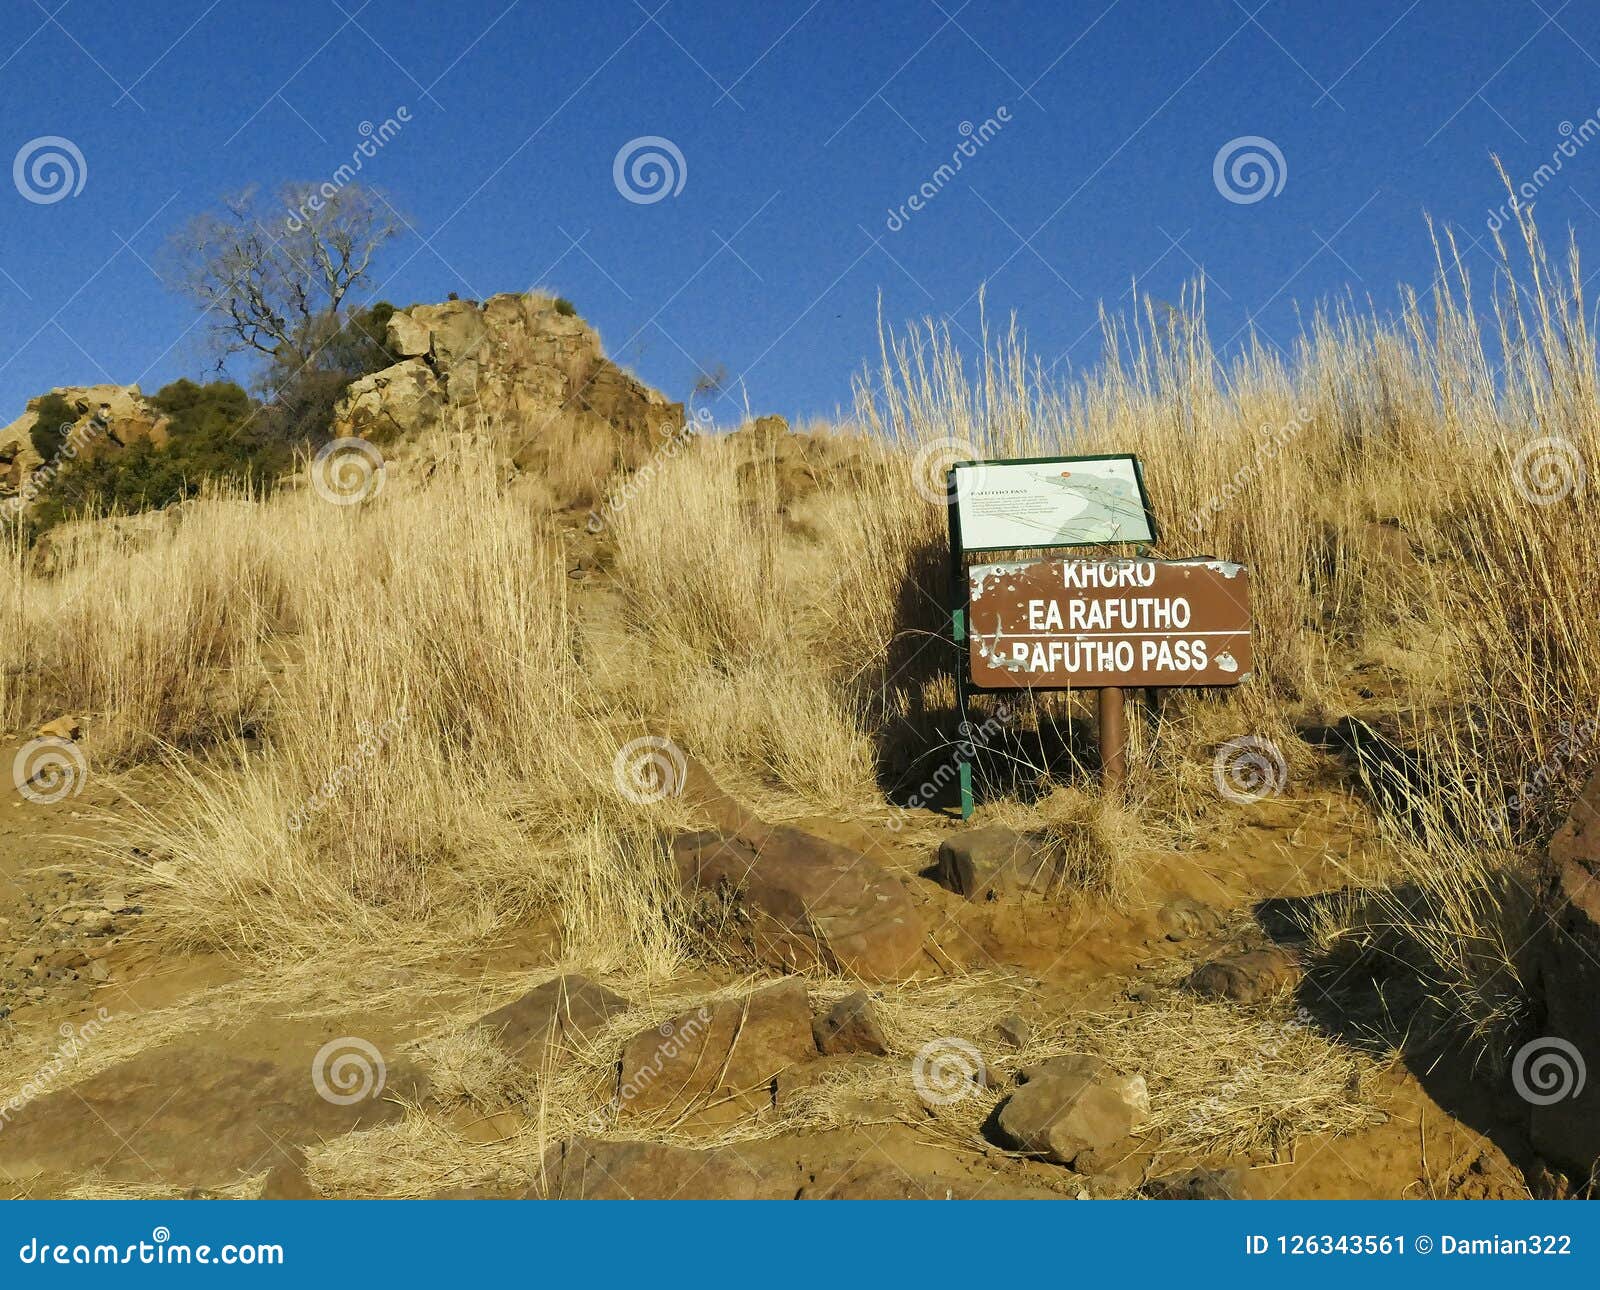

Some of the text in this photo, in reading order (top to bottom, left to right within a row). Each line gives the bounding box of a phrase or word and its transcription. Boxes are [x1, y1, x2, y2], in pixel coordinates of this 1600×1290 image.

[1062, 559, 1156, 588] KHORO
[1028, 597, 1191, 630] EA RAFUTHO
[1010, 639, 1208, 673] RAFUTHO PASS
